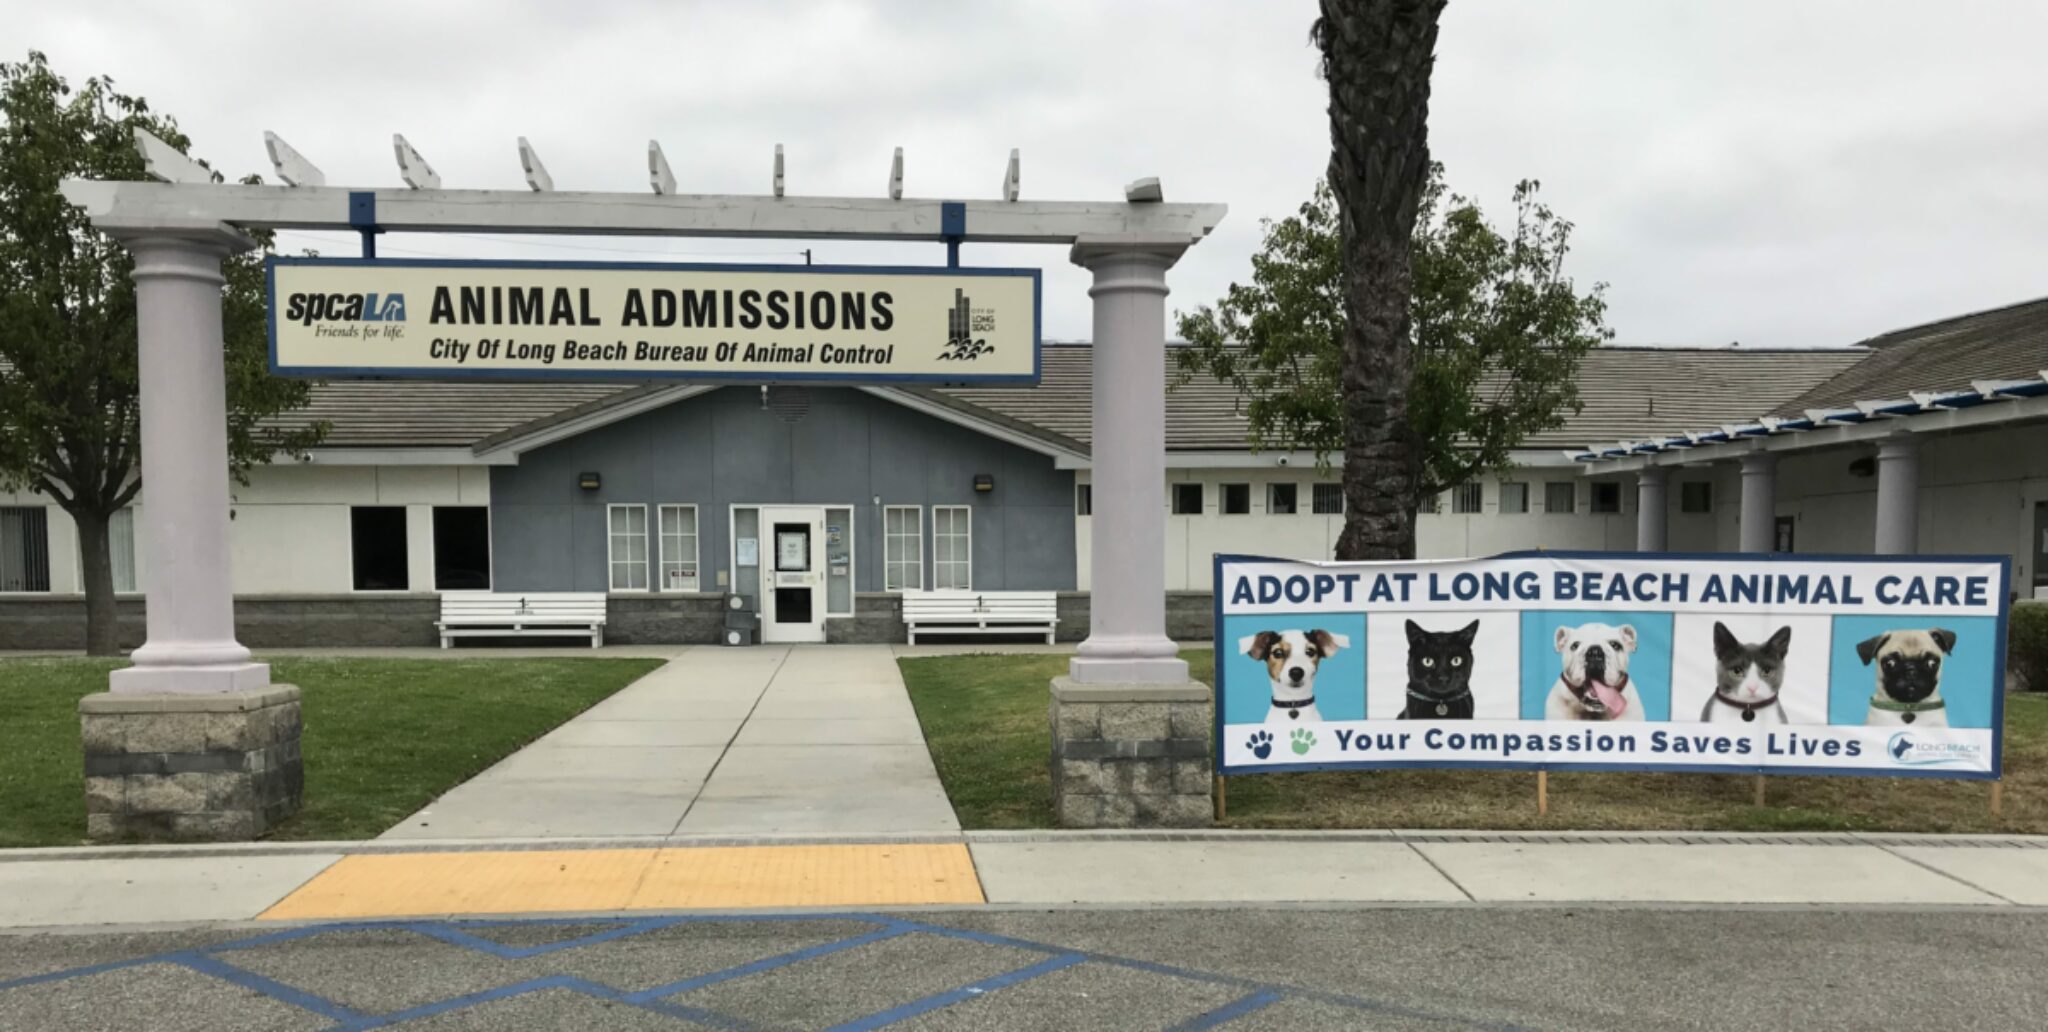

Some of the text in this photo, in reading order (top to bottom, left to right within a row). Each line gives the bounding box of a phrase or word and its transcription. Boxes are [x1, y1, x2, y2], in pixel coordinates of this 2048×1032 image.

[429, 286, 894, 331] ANIMAL ADMISSIONS
[972, 315, 995, 323] LONG
[315, 324, 359, 337] Friends
[362, 324, 379, 341] for
[972, 324, 995, 332] BEACH
[429, 338, 894, 364] City Of Long Beach Bureau Of Animal Control
[1231, 571, 1989, 606] ADOPT AT LONG BEACH ANIMAL CARE
[1335, 728, 1862, 756] Your Compassion Saves Lives
